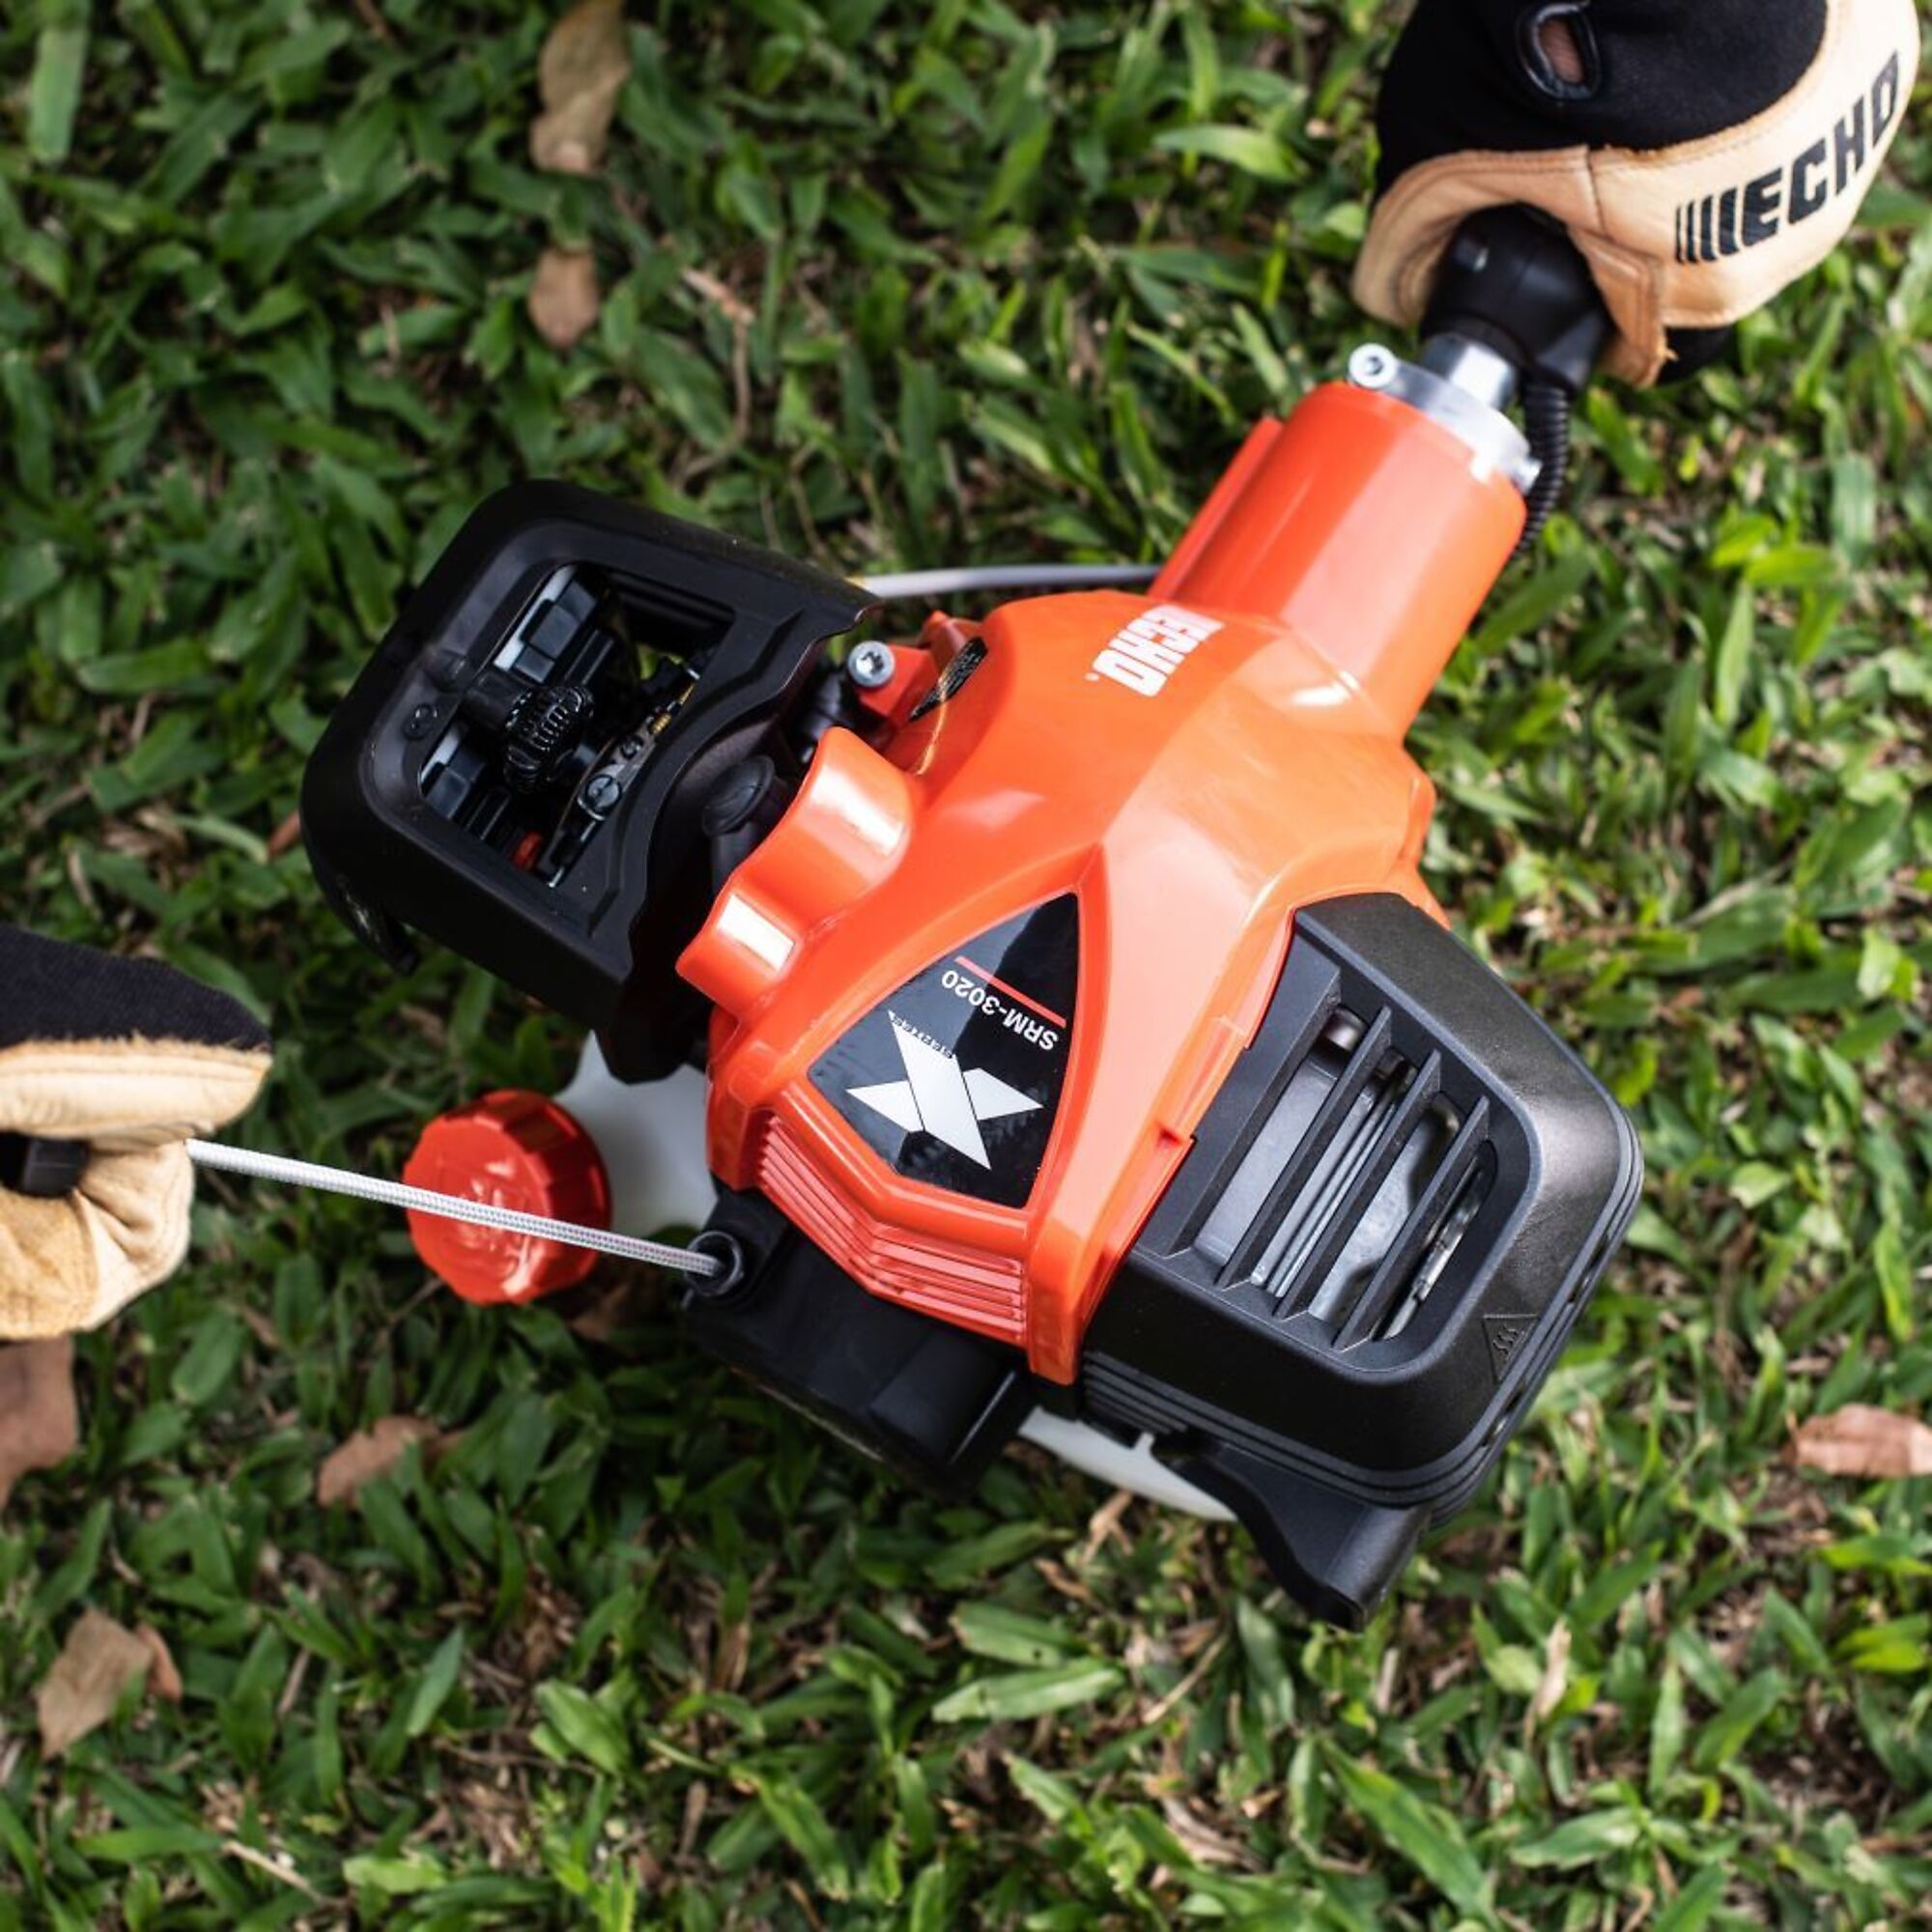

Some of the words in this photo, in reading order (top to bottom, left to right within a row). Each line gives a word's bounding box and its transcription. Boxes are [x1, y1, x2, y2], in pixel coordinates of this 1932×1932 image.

[1741, 49, 1899, 247] ECHO
[1093, 607, 1221, 696] ECHO
[941, 970, 1060, 1051] SRM-3020
